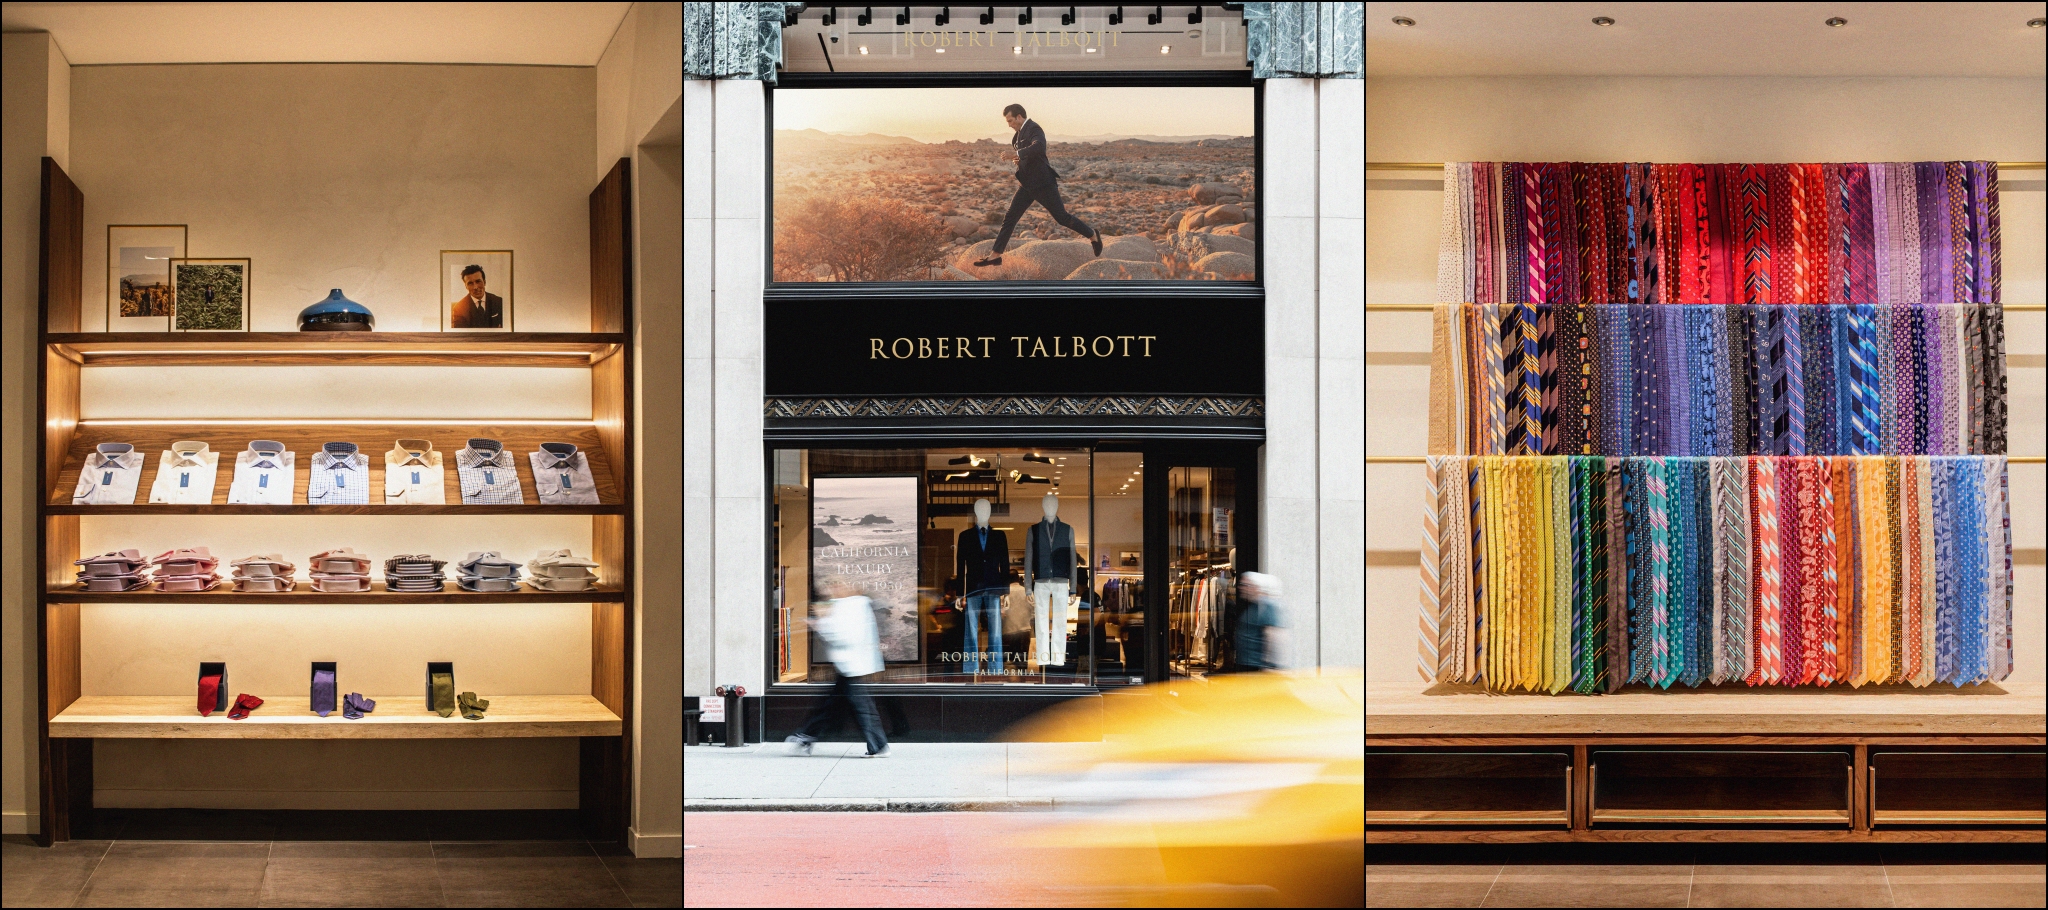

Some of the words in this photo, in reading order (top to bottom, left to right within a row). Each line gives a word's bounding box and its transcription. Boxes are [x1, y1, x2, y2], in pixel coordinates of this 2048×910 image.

[904, 31, 999, 47] ROBERT
[1014, 30, 1122, 47] TALBOTT
[869, 336, 996, 359] ROBERT
[1010, 335, 1157, 358] TALBOTT
[821, 546, 910, 558] CALIFORNIA
[837, 563, 894, 575] LUXURY
[874, 581, 903, 591] 1950
[941, 651, 998, 662] ROBERT
[973, 668, 1035, 676] CALIFORNIA
